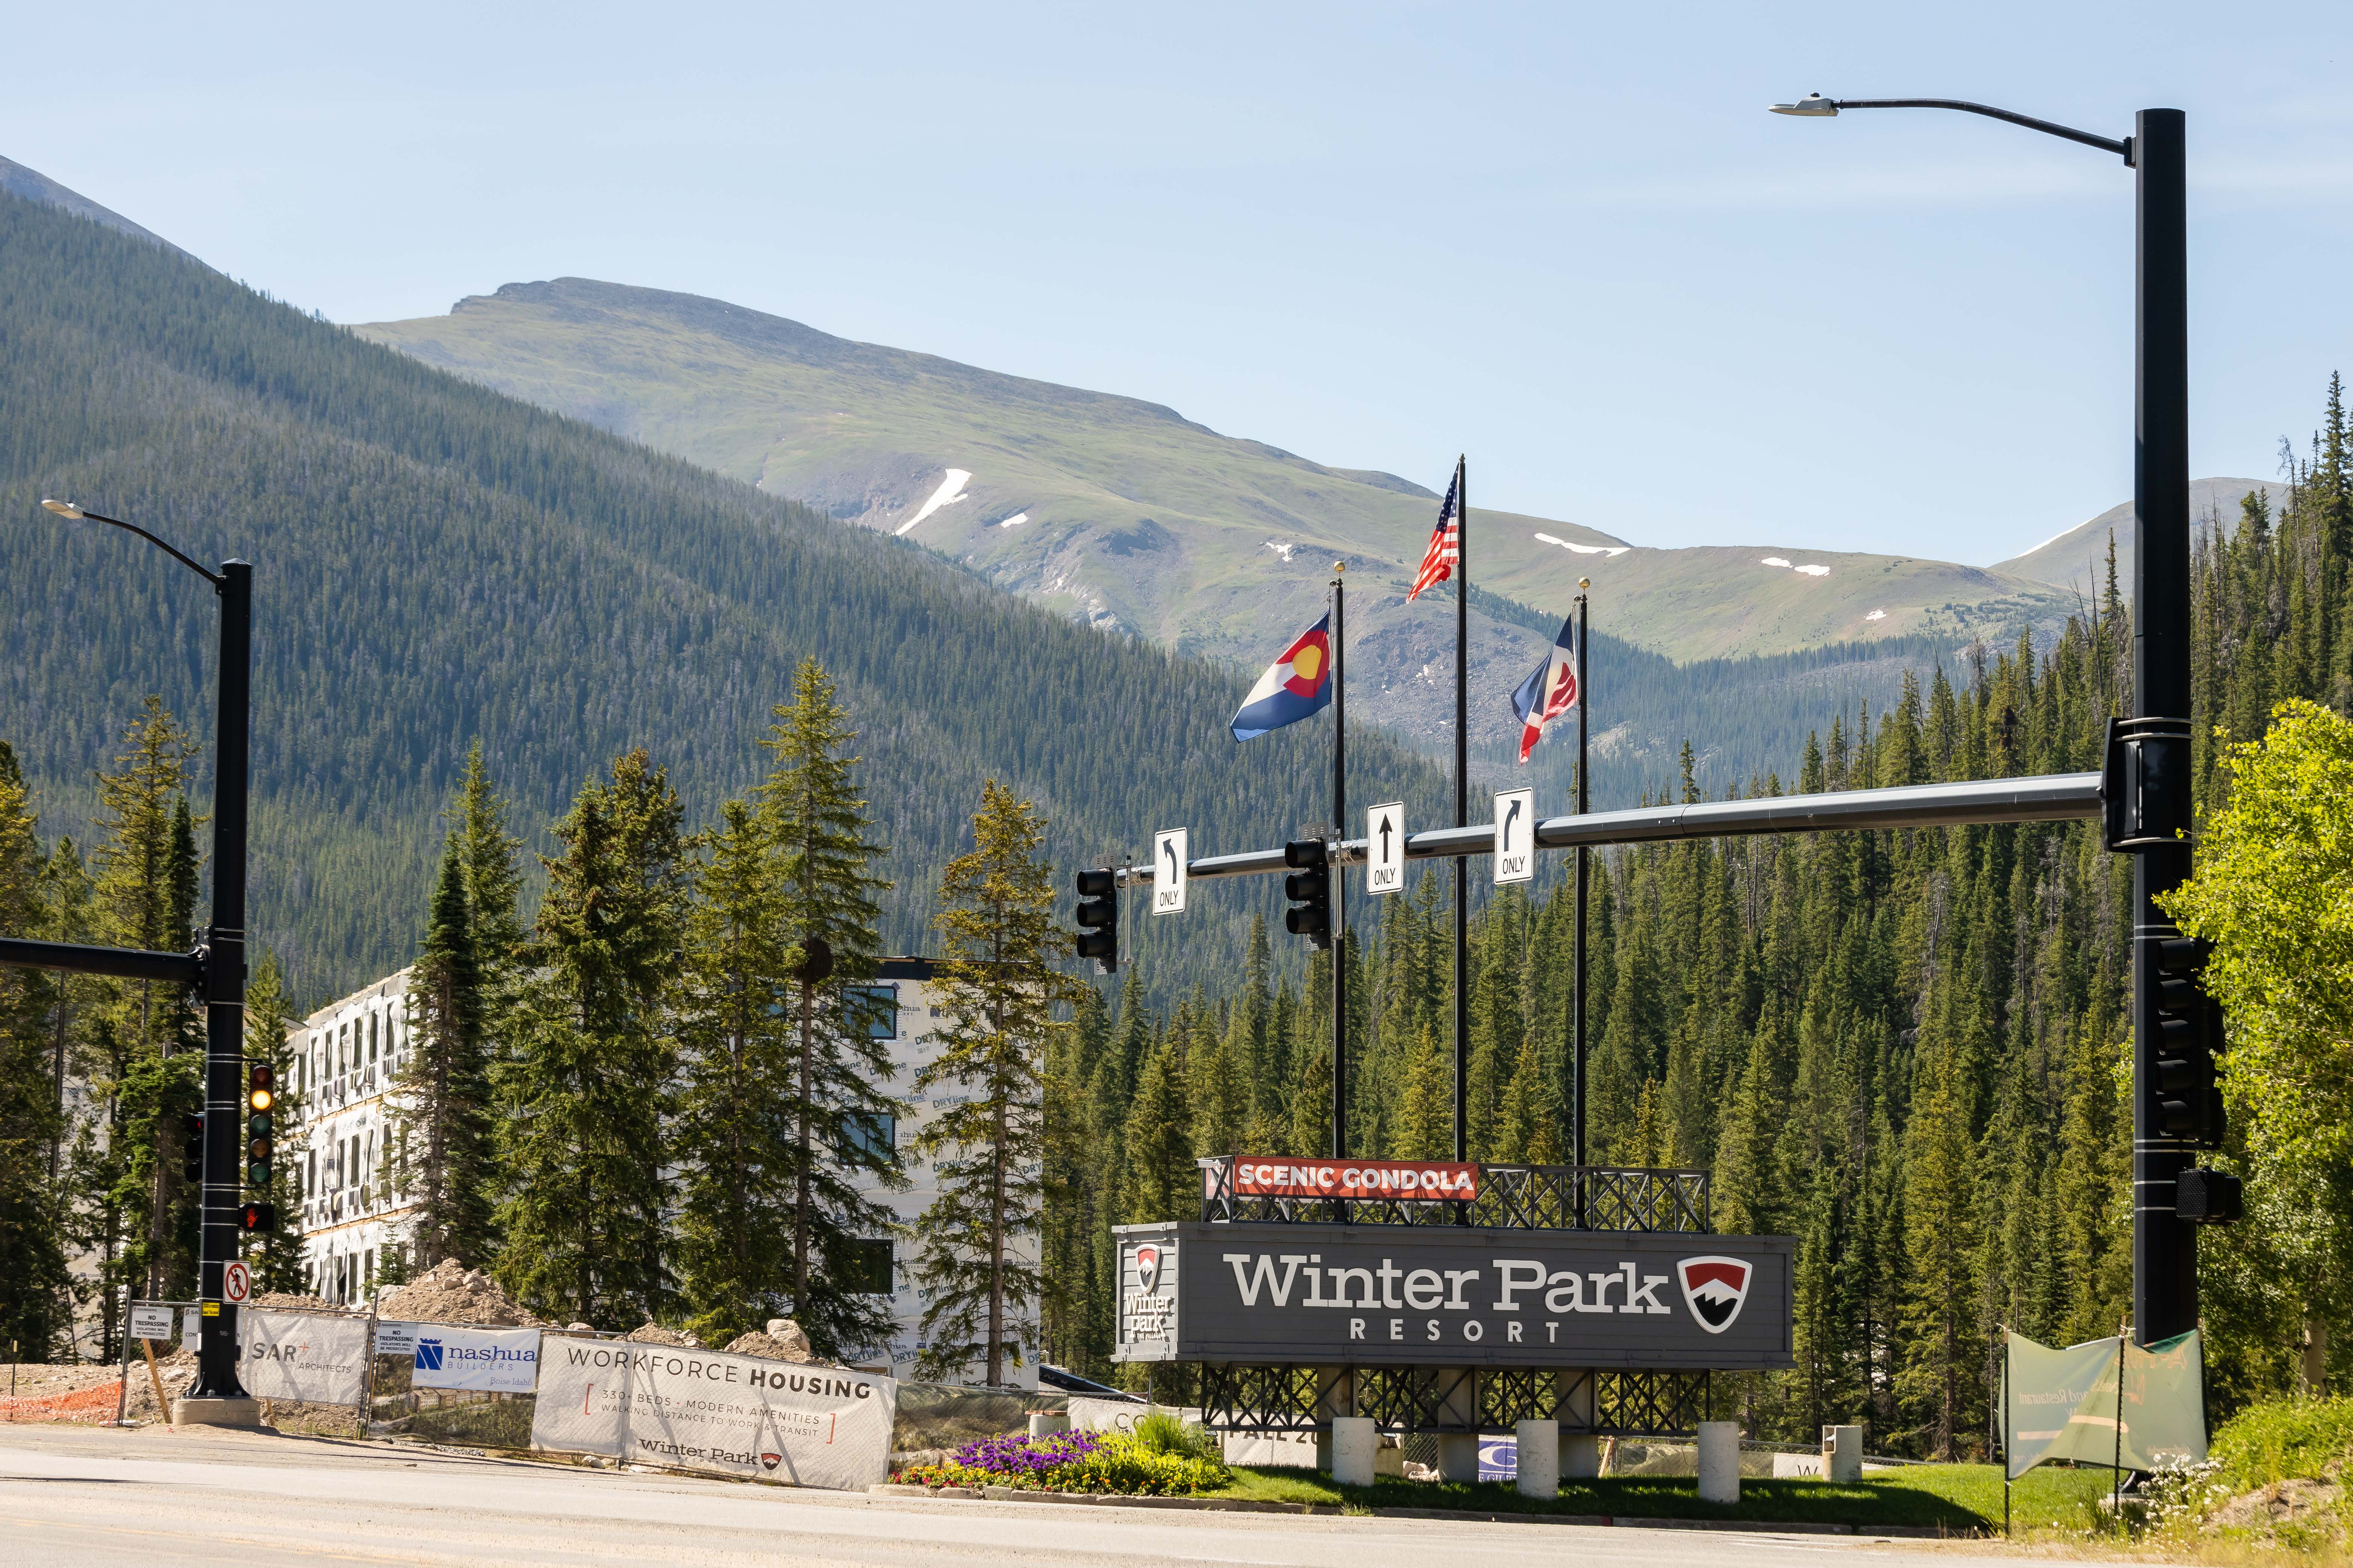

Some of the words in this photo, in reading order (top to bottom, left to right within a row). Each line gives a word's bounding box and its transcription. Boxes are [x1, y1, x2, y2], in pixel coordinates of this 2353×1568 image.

[1374, 867, 1395, 885] ONLY
[1503, 856, 1525, 875] ONLY
[1160, 890, 1179, 906] ONLY
[1238, 1163, 1335, 1188] SCENIC
[1342, 1168, 1474, 1191] GONDOLA
[1222, 1254, 1479, 1310] Winter
[1492, 1259, 1671, 1314] Park
[1124, 1292, 1172, 1315] Winter
[1350, 1318, 1559, 1343] RESORT
[448, 1346, 537, 1362] nashua
[299, 1362, 352, 1373] ARCHITECTS
[448, 1361, 513, 1371] BUILDERS
[568, 1348, 738, 1383] WORKFORCE
[750, 1369, 871, 1399] HOUSING
[490, 1377, 511, 1385] Boise
[602, 1390, 632, 1400] 330+
[637, 1394, 671, 1406] BEDS
[686, 1400, 743, 1415] MODERN
[750, 1408, 820, 1424] AMENITIES
[601, 1404, 648, 1416] WALKING
[653, 1410, 706, 1423] DISTANCE
[710, 1416, 724, 1425] TO
[728, 1419, 760, 1430] WORK
[775, 1424, 818, 1437] TRANSIT
[639, 1438, 706, 1457] Winter
[710, 1448, 758, 1465] Park
[677, 1456, 719, 1465] RESORT
